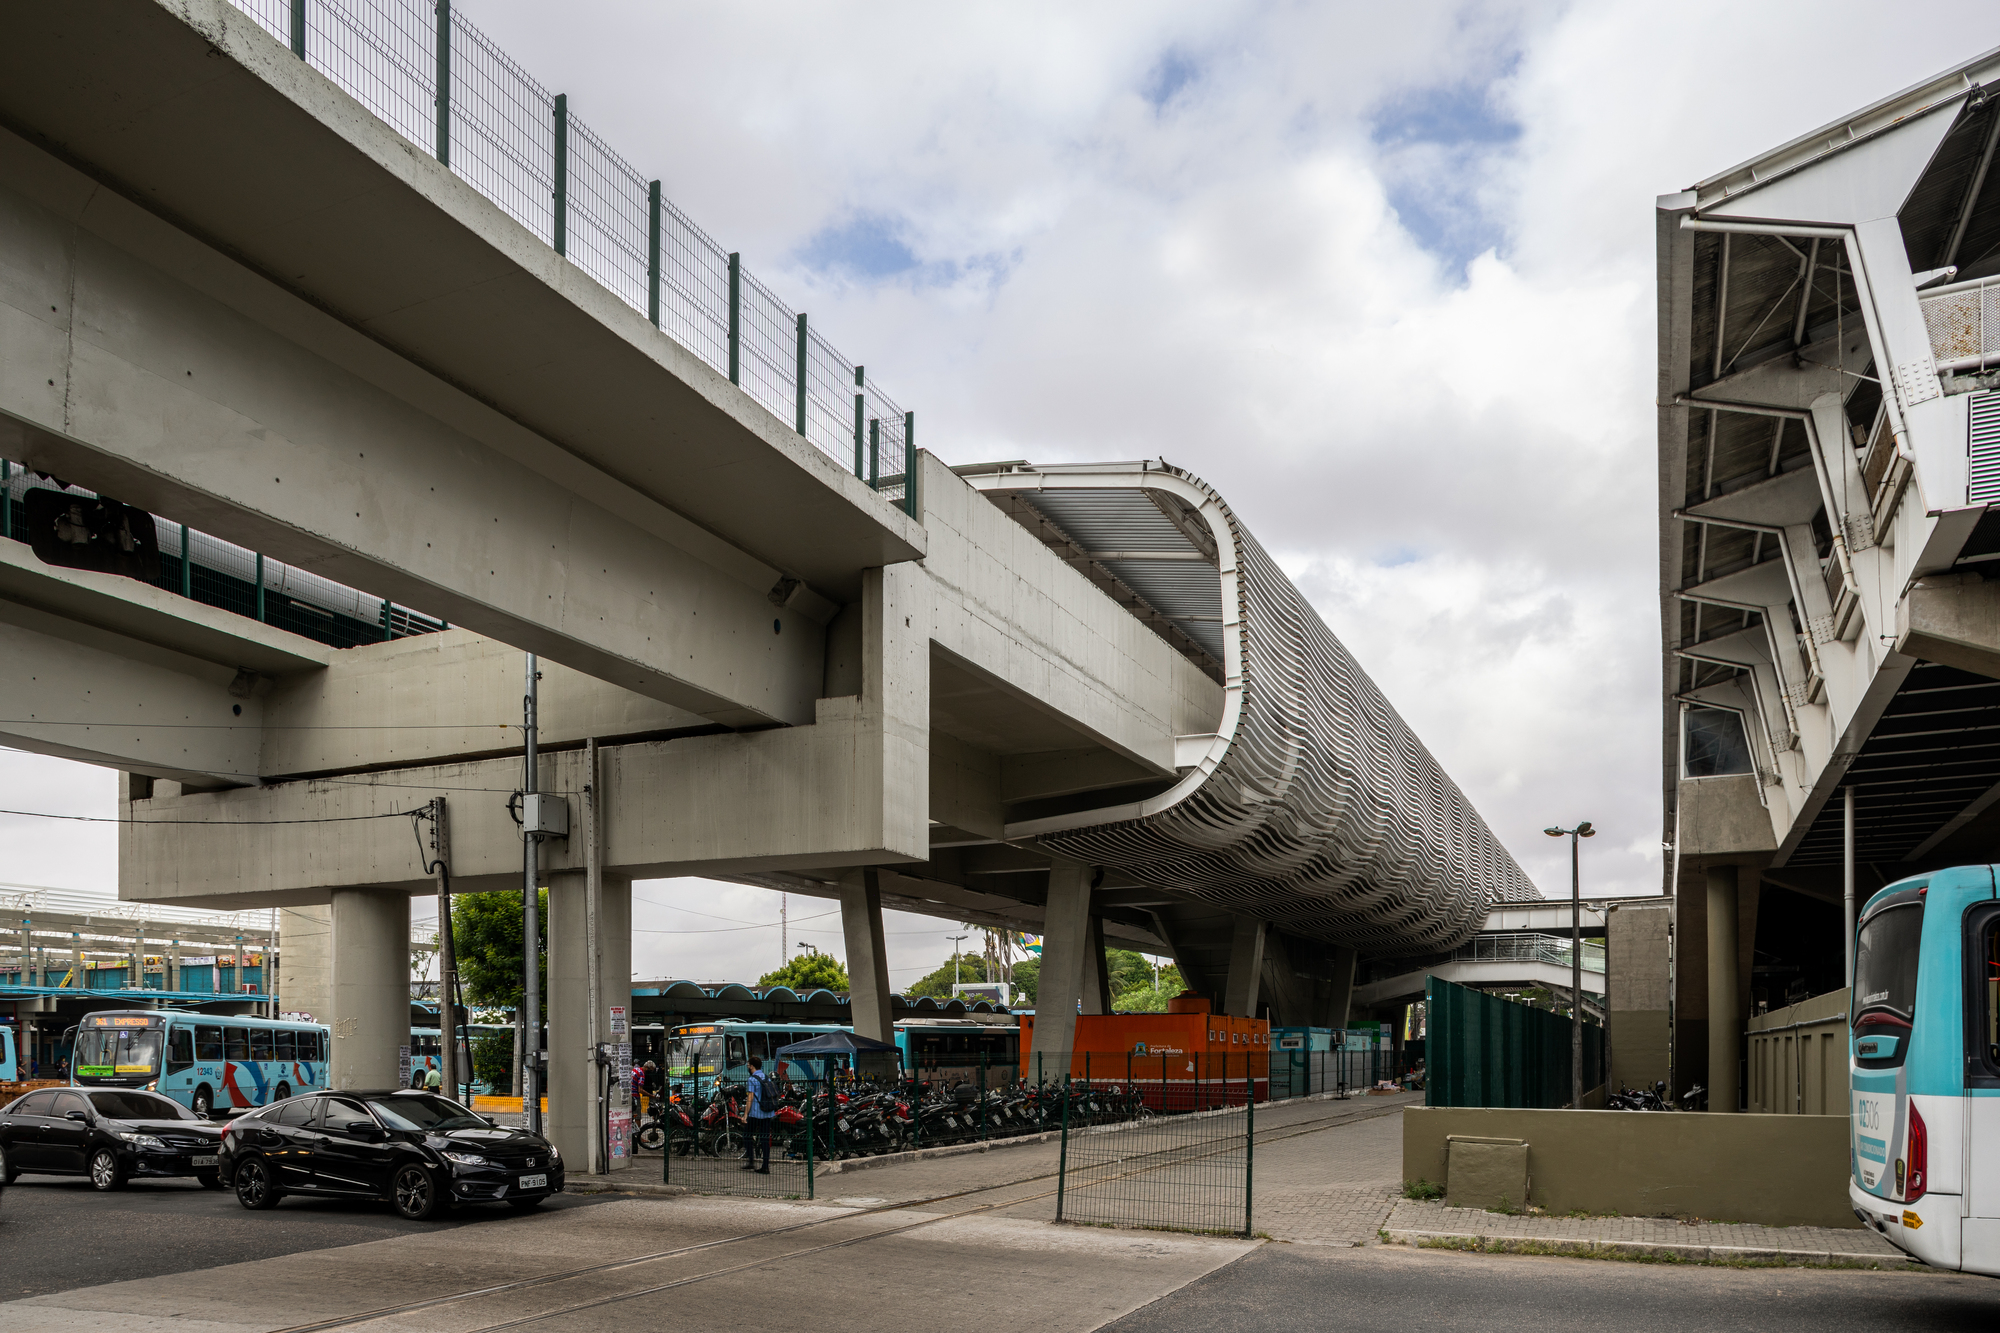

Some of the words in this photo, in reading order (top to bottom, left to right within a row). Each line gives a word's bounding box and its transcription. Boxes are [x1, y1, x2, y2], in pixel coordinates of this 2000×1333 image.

[114, 1017, 149, 1026] EXPRESSO
[197, 1067, 213, 1076] 12343
[1859, 1099, 1879, 1130] 02506
